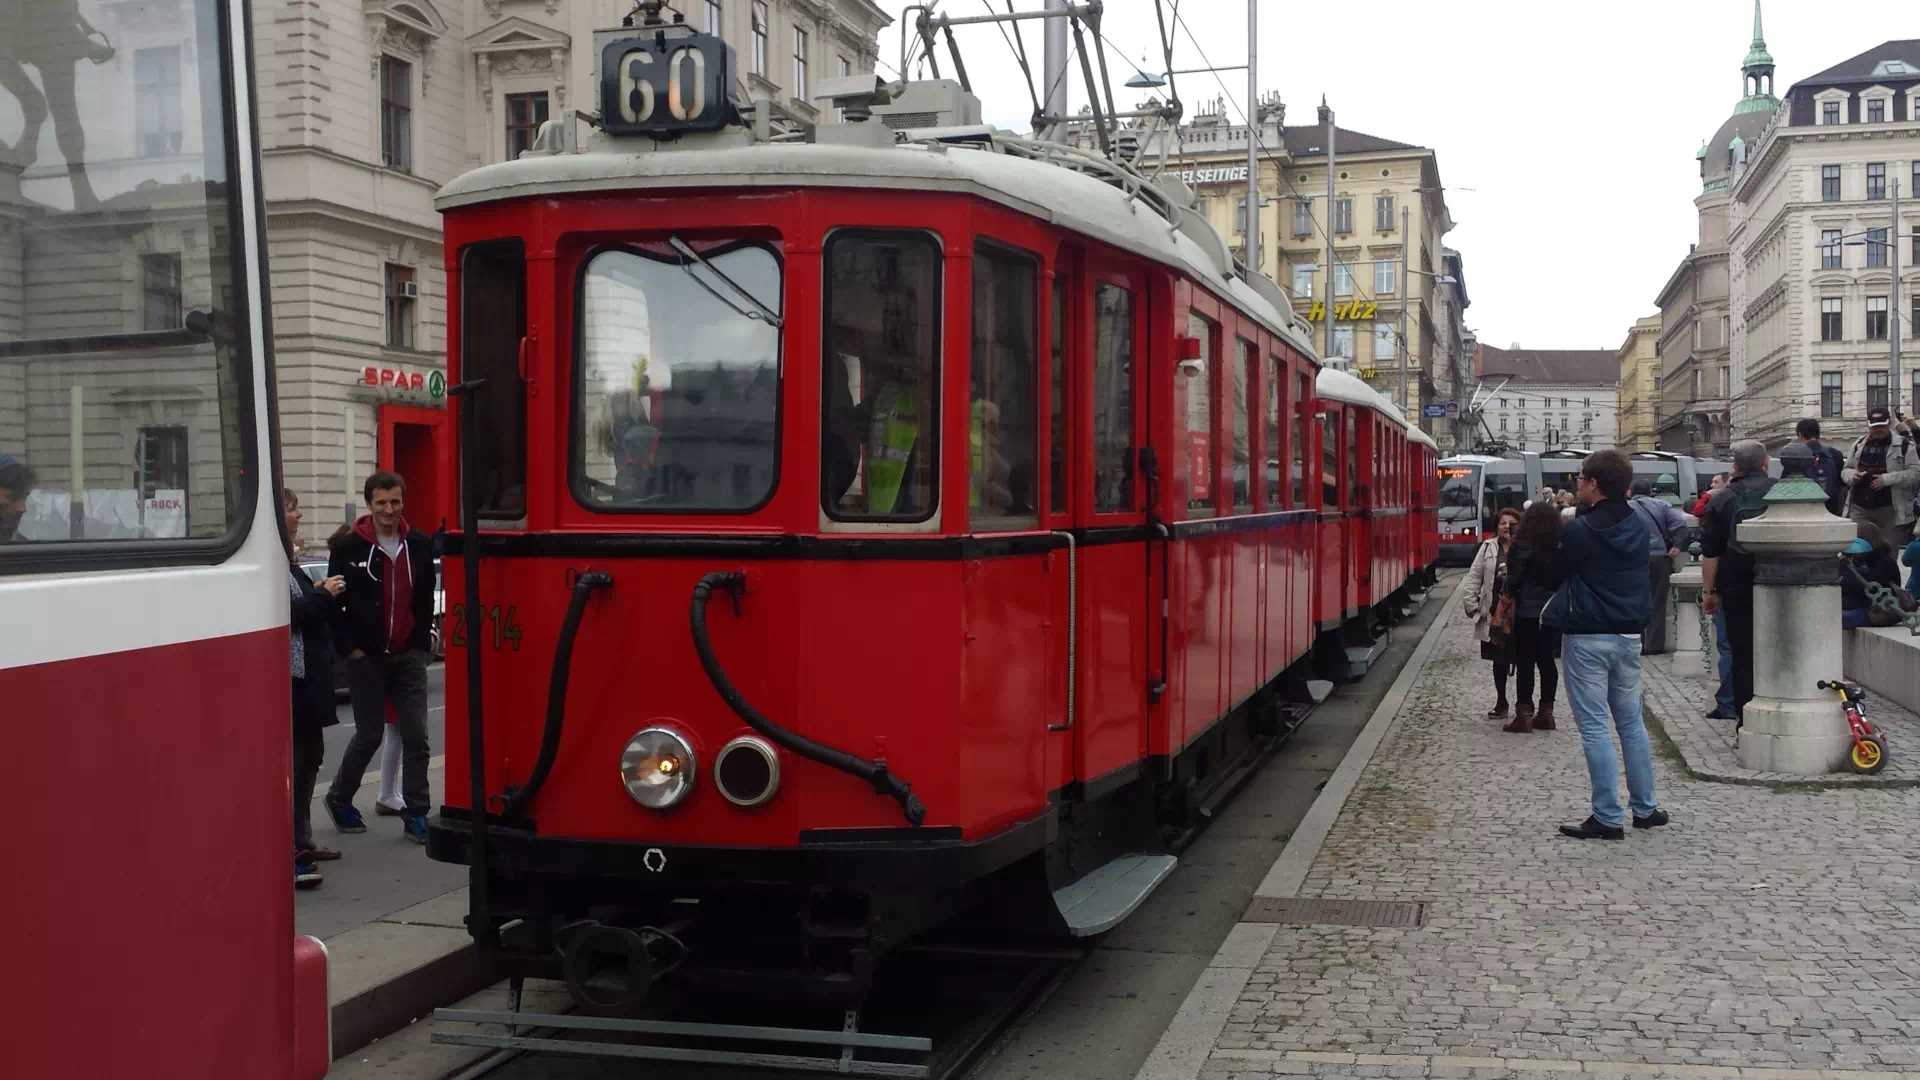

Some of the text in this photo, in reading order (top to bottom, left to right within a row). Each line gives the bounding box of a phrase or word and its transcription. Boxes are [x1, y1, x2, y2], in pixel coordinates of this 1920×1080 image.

[619, 48, 705, 123] 60
[1308, 299, 1377, 320] Hrtz
[364, 366, 424, 391] SPAR
[452, 604, 524, 652] 214
